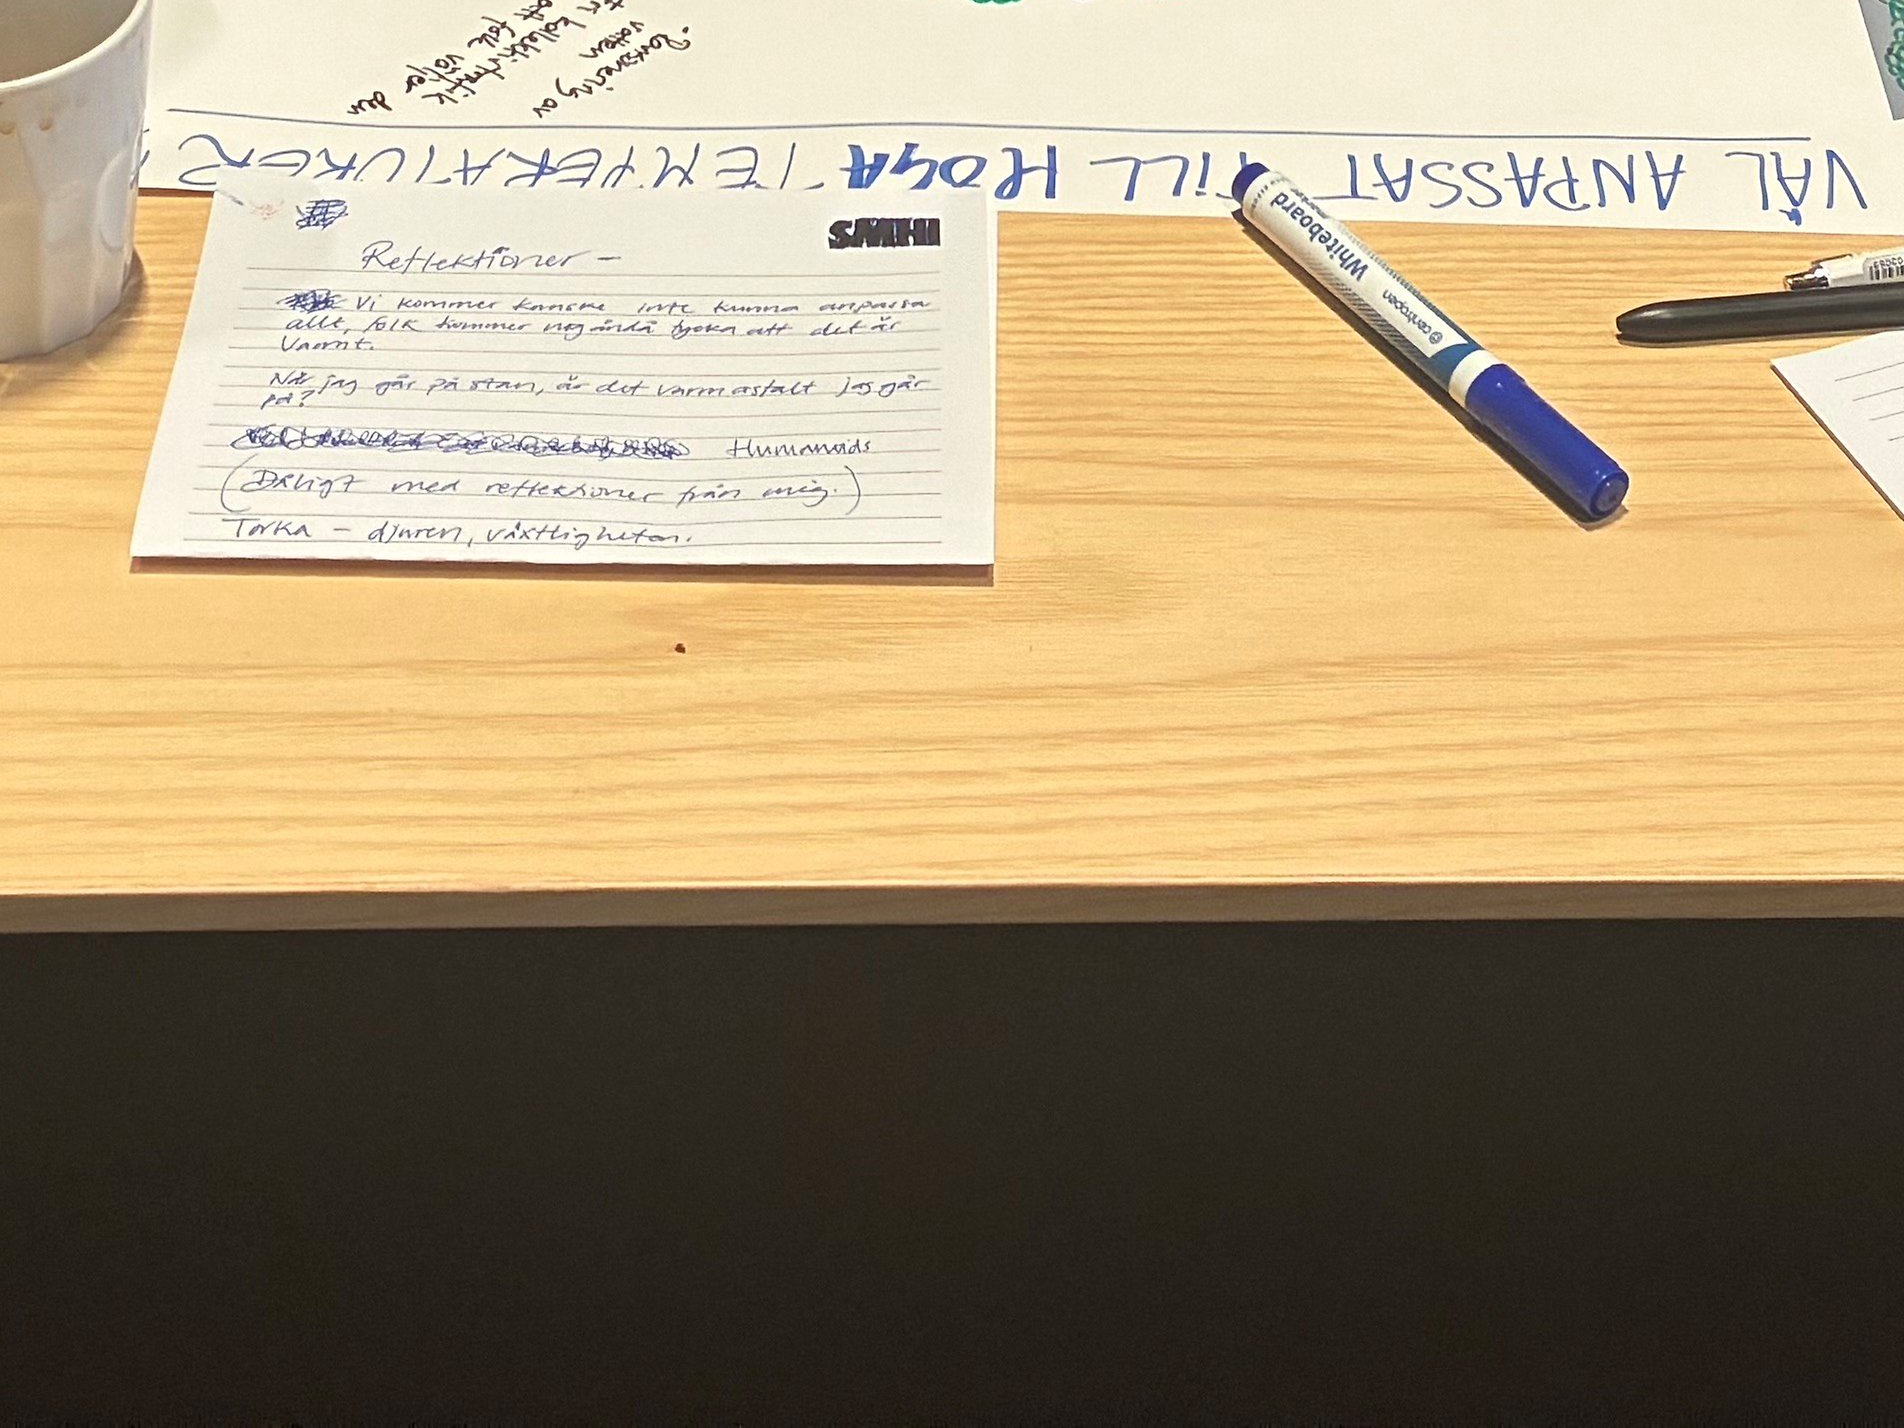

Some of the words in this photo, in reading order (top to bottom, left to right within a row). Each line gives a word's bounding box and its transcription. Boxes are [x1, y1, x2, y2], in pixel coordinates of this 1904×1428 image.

[1312, 150, 1687, 211] ANPASSAT
[828, 217, 941, 250] SMHI
[1270, 191, 1369, 282] Whiteboard
